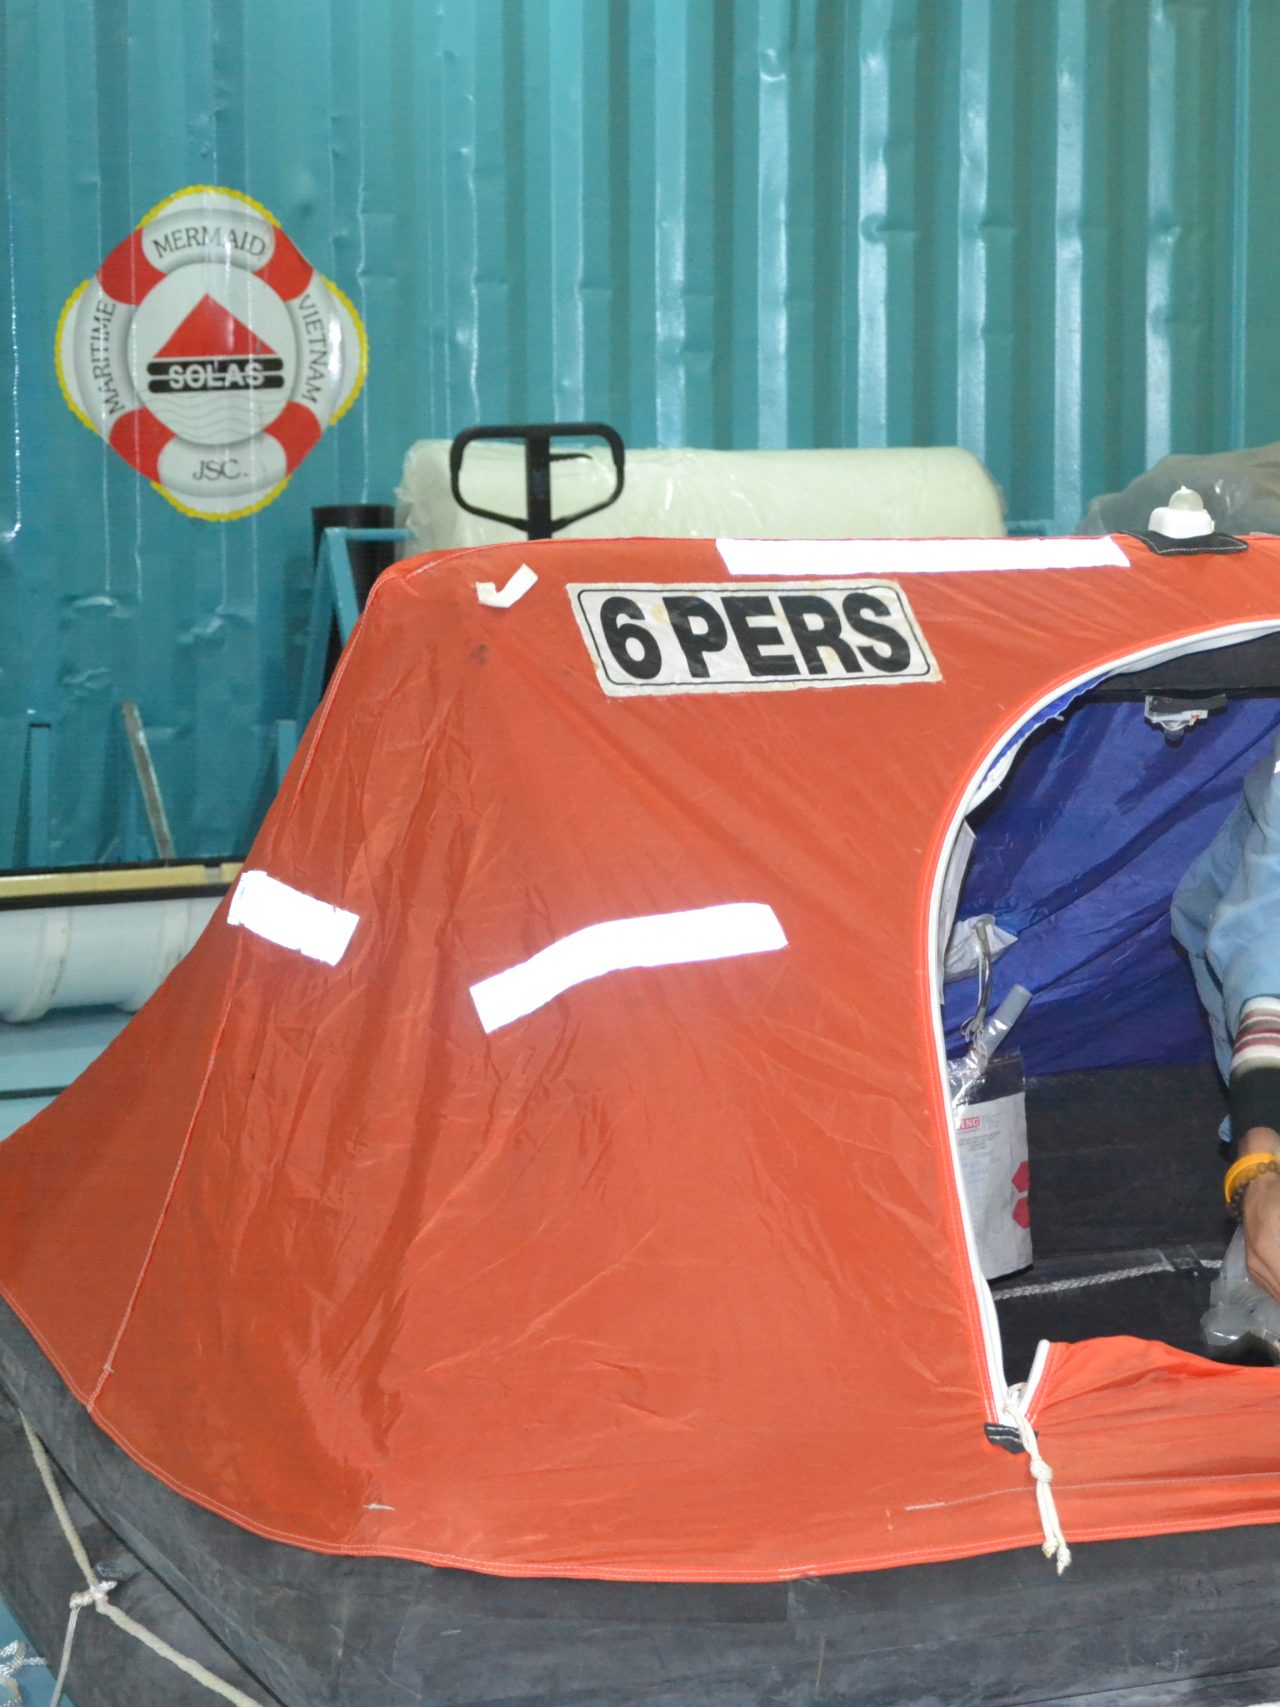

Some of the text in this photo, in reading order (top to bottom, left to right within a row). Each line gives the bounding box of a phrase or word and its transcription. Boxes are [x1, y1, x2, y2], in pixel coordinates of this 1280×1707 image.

[153, 225, 267, 259] MERMAID
[90, 299, 125, 415] MARITIME
[168, 361, 265, 390] SOLAS
[297, 294, 327, 404] VIETNAM
[600, 592, 911, 680] 6 PERS
